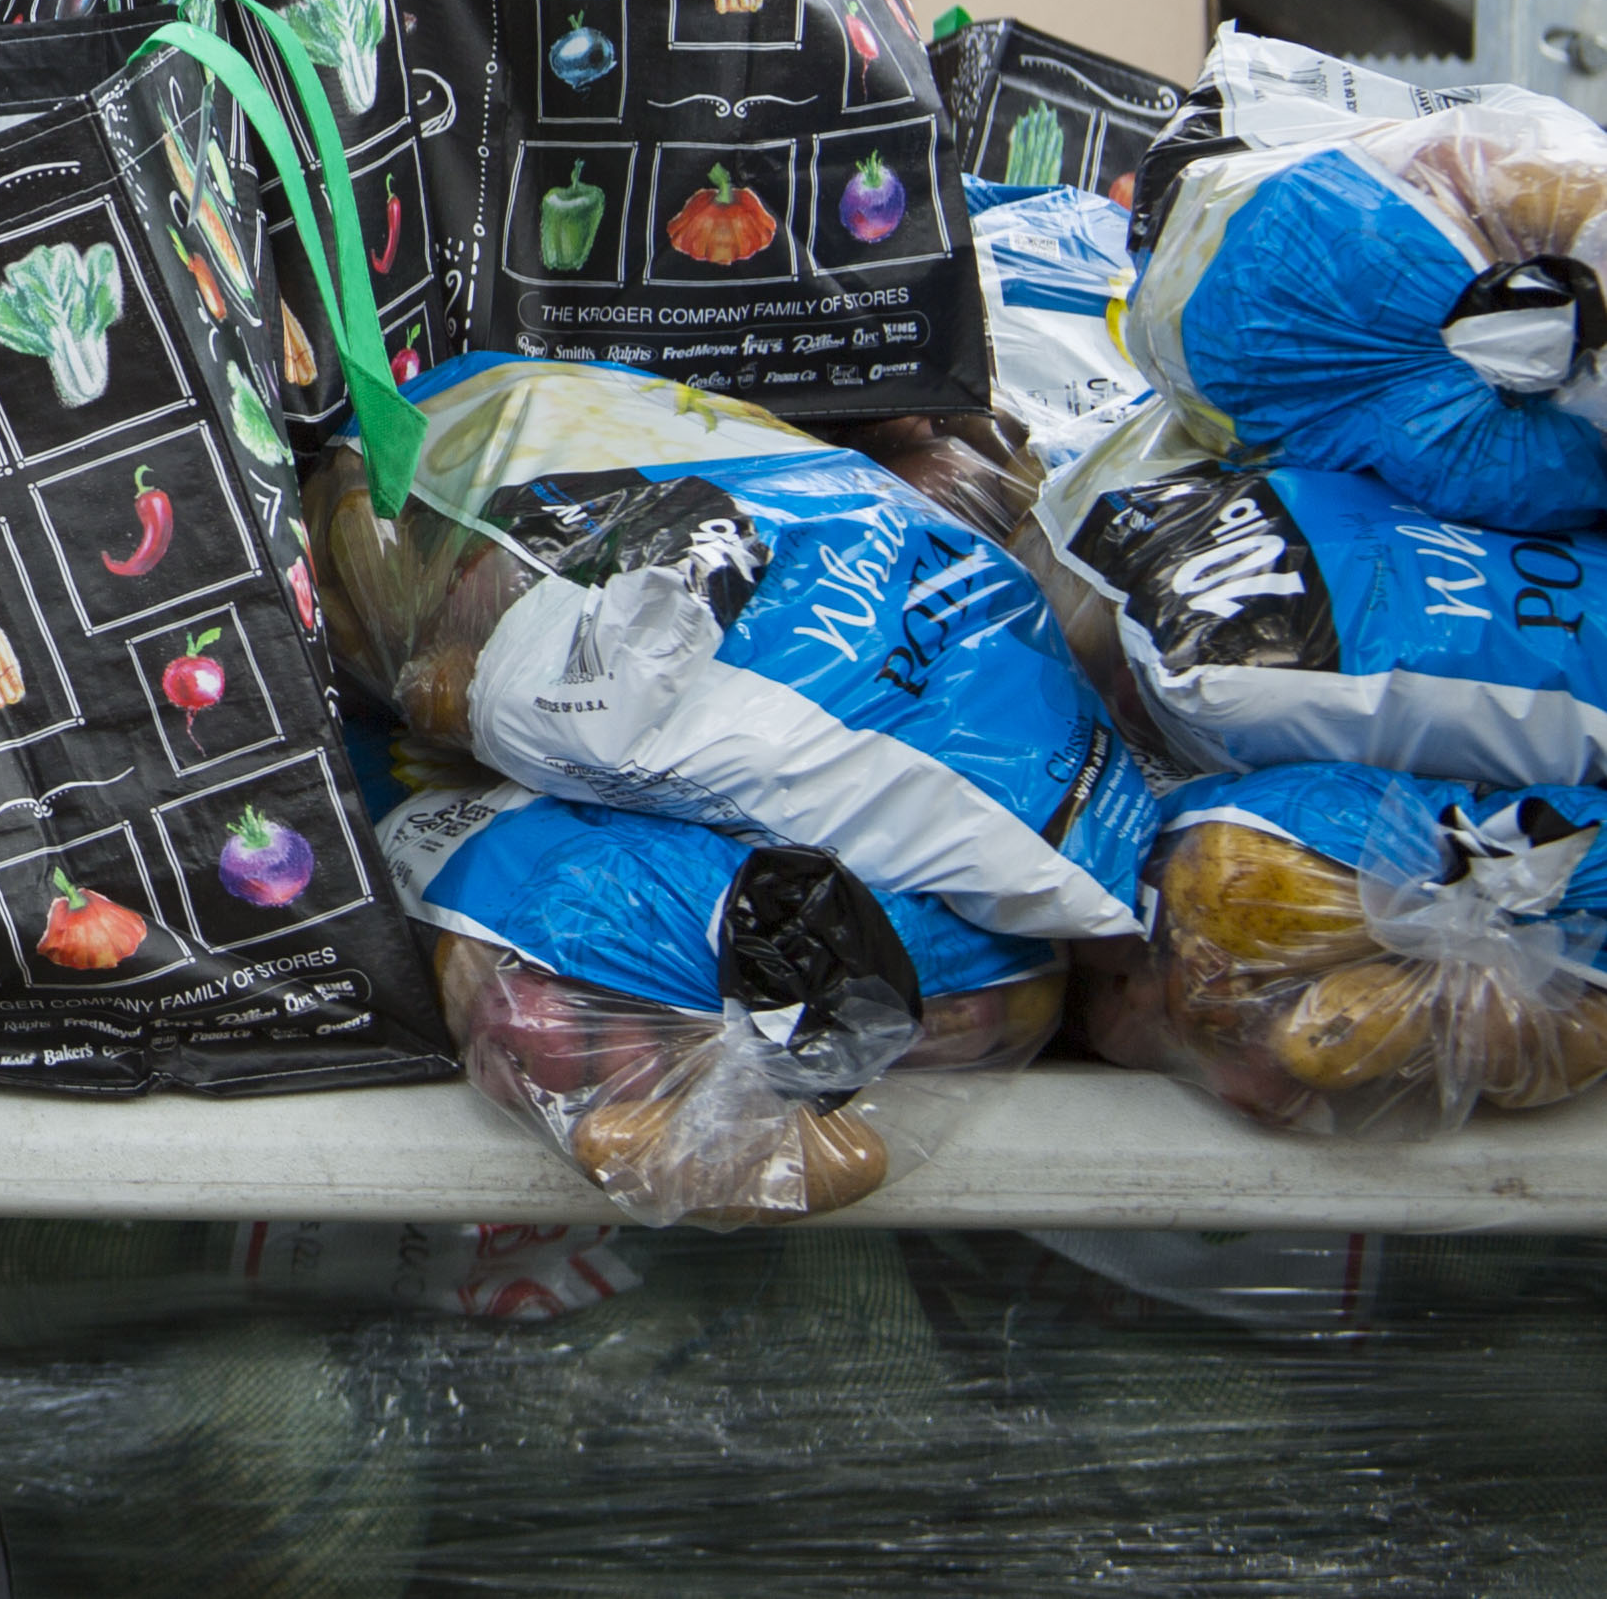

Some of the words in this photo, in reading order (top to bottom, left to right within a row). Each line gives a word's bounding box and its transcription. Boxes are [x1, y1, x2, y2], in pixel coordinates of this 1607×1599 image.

[541, 305, 573, 322] THE
[578, 305, 652, 323] KROGER
[659, 304, 750, 324] COMPANY
[753, 299, 817, 317] FAMILY
[820, 296, 842, 313] OF
[844, 287, 909, 309] STORES
[554, 345, 595, 361] Smith's
[607, 345, 652, 364] Ralphs
[1073, 765, 1101, 801] with
[1093, 754, 1103, 767] a
[50, 997, 153, 1014] COMPANY
[160, 977, 228, 1010] FAMILY
[232, 964, 256, 989] OF
[254, 947, 337, 979] STORES
[43, 1042, 94, 1066] Baker's
